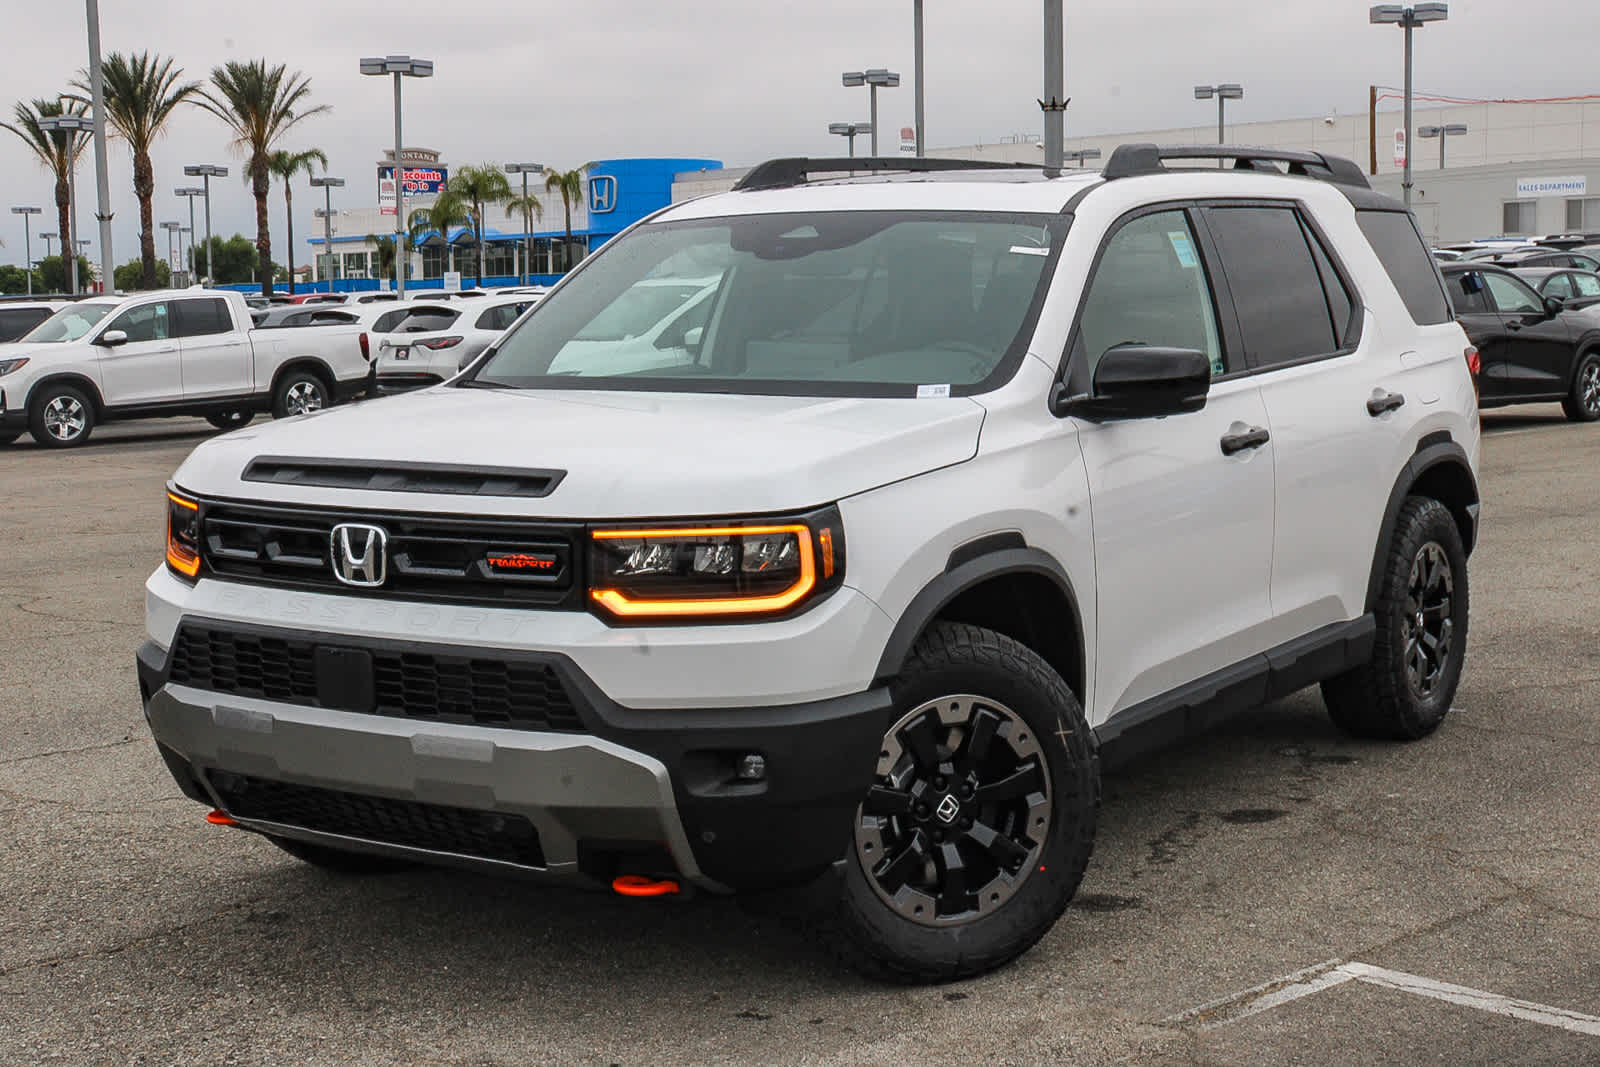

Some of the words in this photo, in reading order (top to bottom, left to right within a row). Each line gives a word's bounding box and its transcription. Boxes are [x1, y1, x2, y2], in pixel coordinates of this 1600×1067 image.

[400, 152, 435, 161] ONTANA
[407, 182, 417, 190] Up
[419, 182, 429, 190] To
[1518, 184, 1538, 192] SALES
[1540, 182, 1585, 192] DEPARTMENT
[487, 558, 554, 569] TRAILSPORT
[217, 588, 542, 637] PASSPORT
